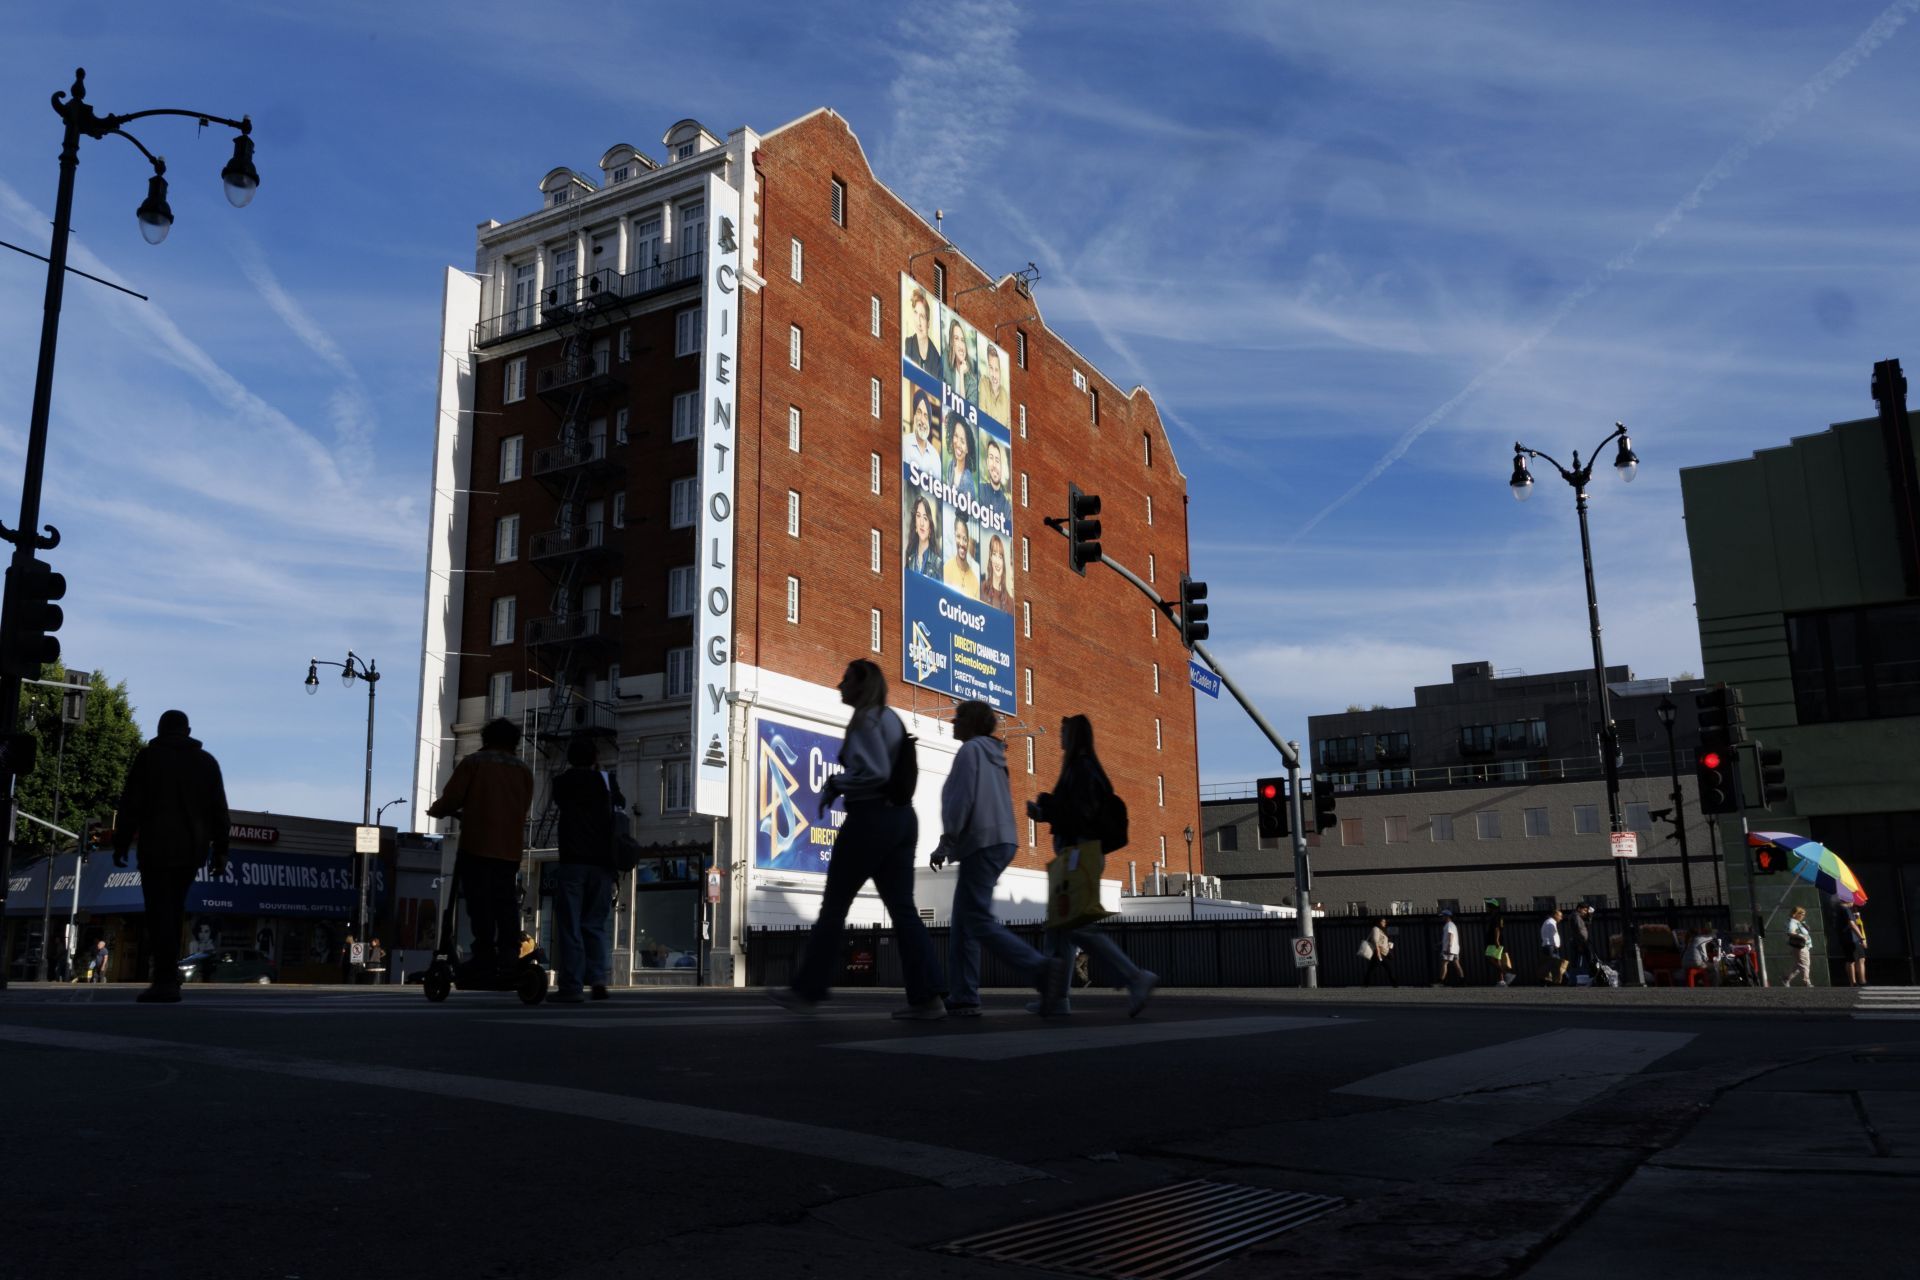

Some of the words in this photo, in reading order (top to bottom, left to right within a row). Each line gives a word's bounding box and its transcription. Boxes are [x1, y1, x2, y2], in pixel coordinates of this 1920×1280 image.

[942, 381, 965, 417] I'm
[969, 405, 978, 425] a
[910, 461, 1010, 536] Scientologist.
[938, 598, 986, 632] Curious?
[954, 634, 977, 655] DIRECTV
[976, 643, 1000, 664] CHANNEL
[1000, 652, 1010, 667] 320
[954, 653, 997, 676] scientology.tv
[1190, 667, 1212, 690] McCadden
[1212, 680, 1218, 693] Pl
[229, 825, 275, 840] MARKET
[241, 862, 319, 889] SOUVENIRS
[202, 899, 233, 908] TOURS
